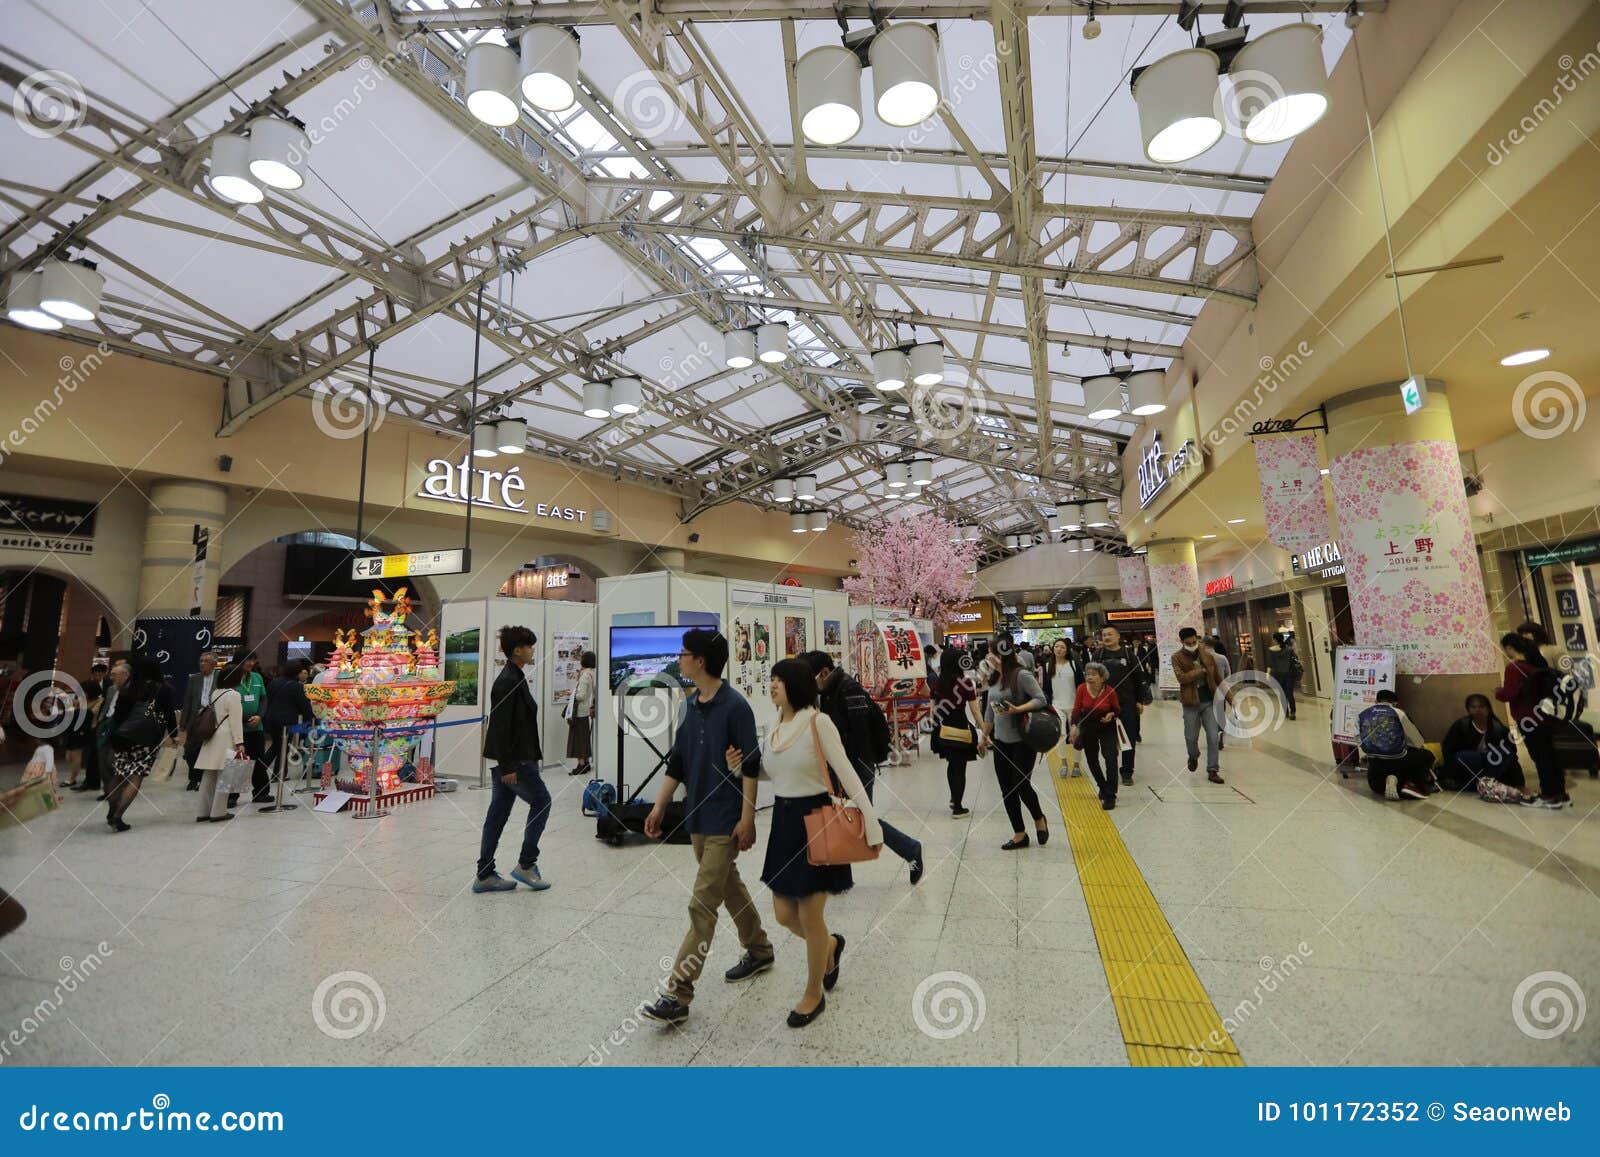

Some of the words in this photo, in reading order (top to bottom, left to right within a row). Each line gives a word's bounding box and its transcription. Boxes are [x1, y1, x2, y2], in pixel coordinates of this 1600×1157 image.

[1138, 428, 1164, 503] atré
[1167, 439, 1193, 478] WEST
[424, 455, 525, 508] atré
[537, 503, 586, 522] EAST
[1302, 546, 1323, 568] THE
[1384, 538, 1434, 556] 上野
[196, 627, 211, 648] の
